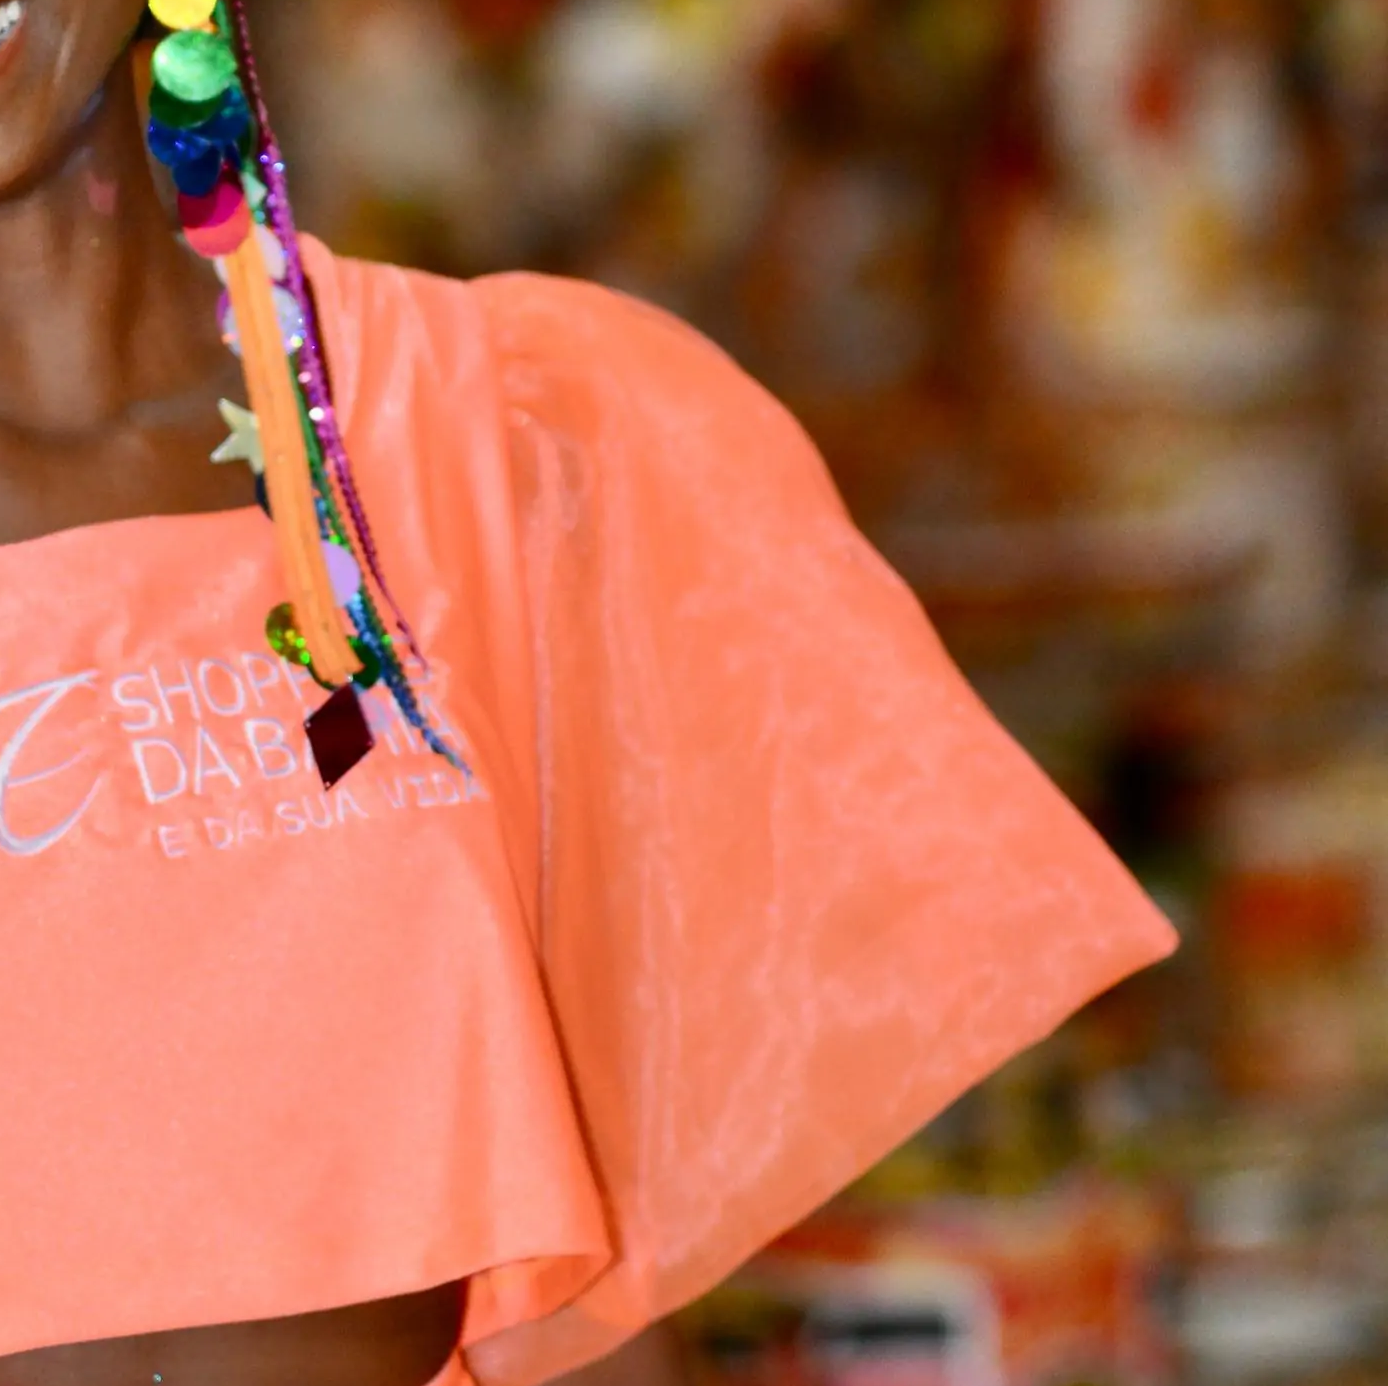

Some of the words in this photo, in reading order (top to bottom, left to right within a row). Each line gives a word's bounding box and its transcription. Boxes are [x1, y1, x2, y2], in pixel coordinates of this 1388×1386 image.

[131, 724, 243, 805] DA
[157, 824, 188, 859] E
[203, 809, 263, 851] DA
[274, 785, 370, 835] SUA
[379, 770, 491, 810] VIDA
